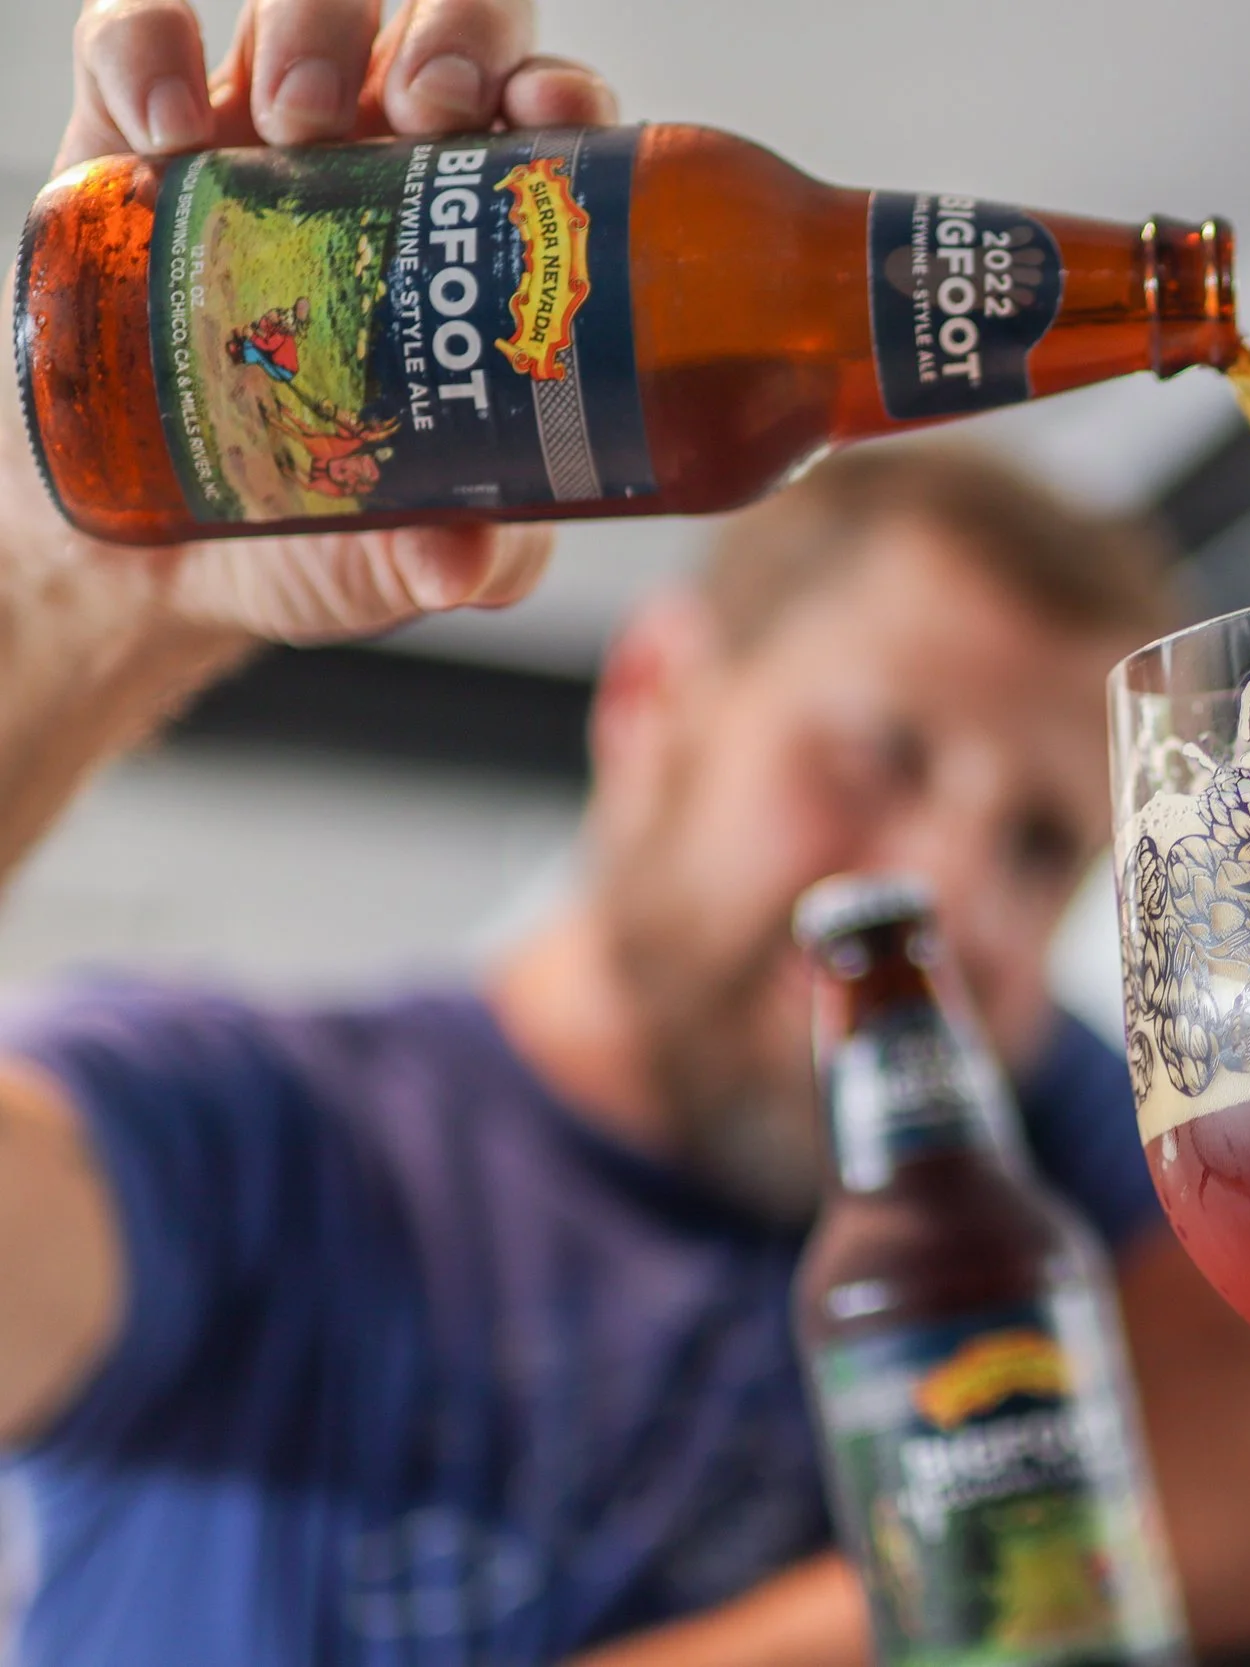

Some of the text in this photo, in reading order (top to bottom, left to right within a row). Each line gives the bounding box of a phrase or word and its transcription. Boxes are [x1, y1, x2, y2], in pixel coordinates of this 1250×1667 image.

[172, 192, 193, 256] BREWING
[429, 148, 488, 411] BIGFOOT
[528, 180, 562, 346] SIERRA NEVADA
[936, 195, 983, 381] BIGFOOT
[981, 230, 1013, 319] 2022
[174, 348, 190, 374] CA
[176, 375, 192, 389] &
[917, 350, 939, 384] ALE
[179, 390, 201, 437] MILLS
[406, 386, 433, 431] ALE
